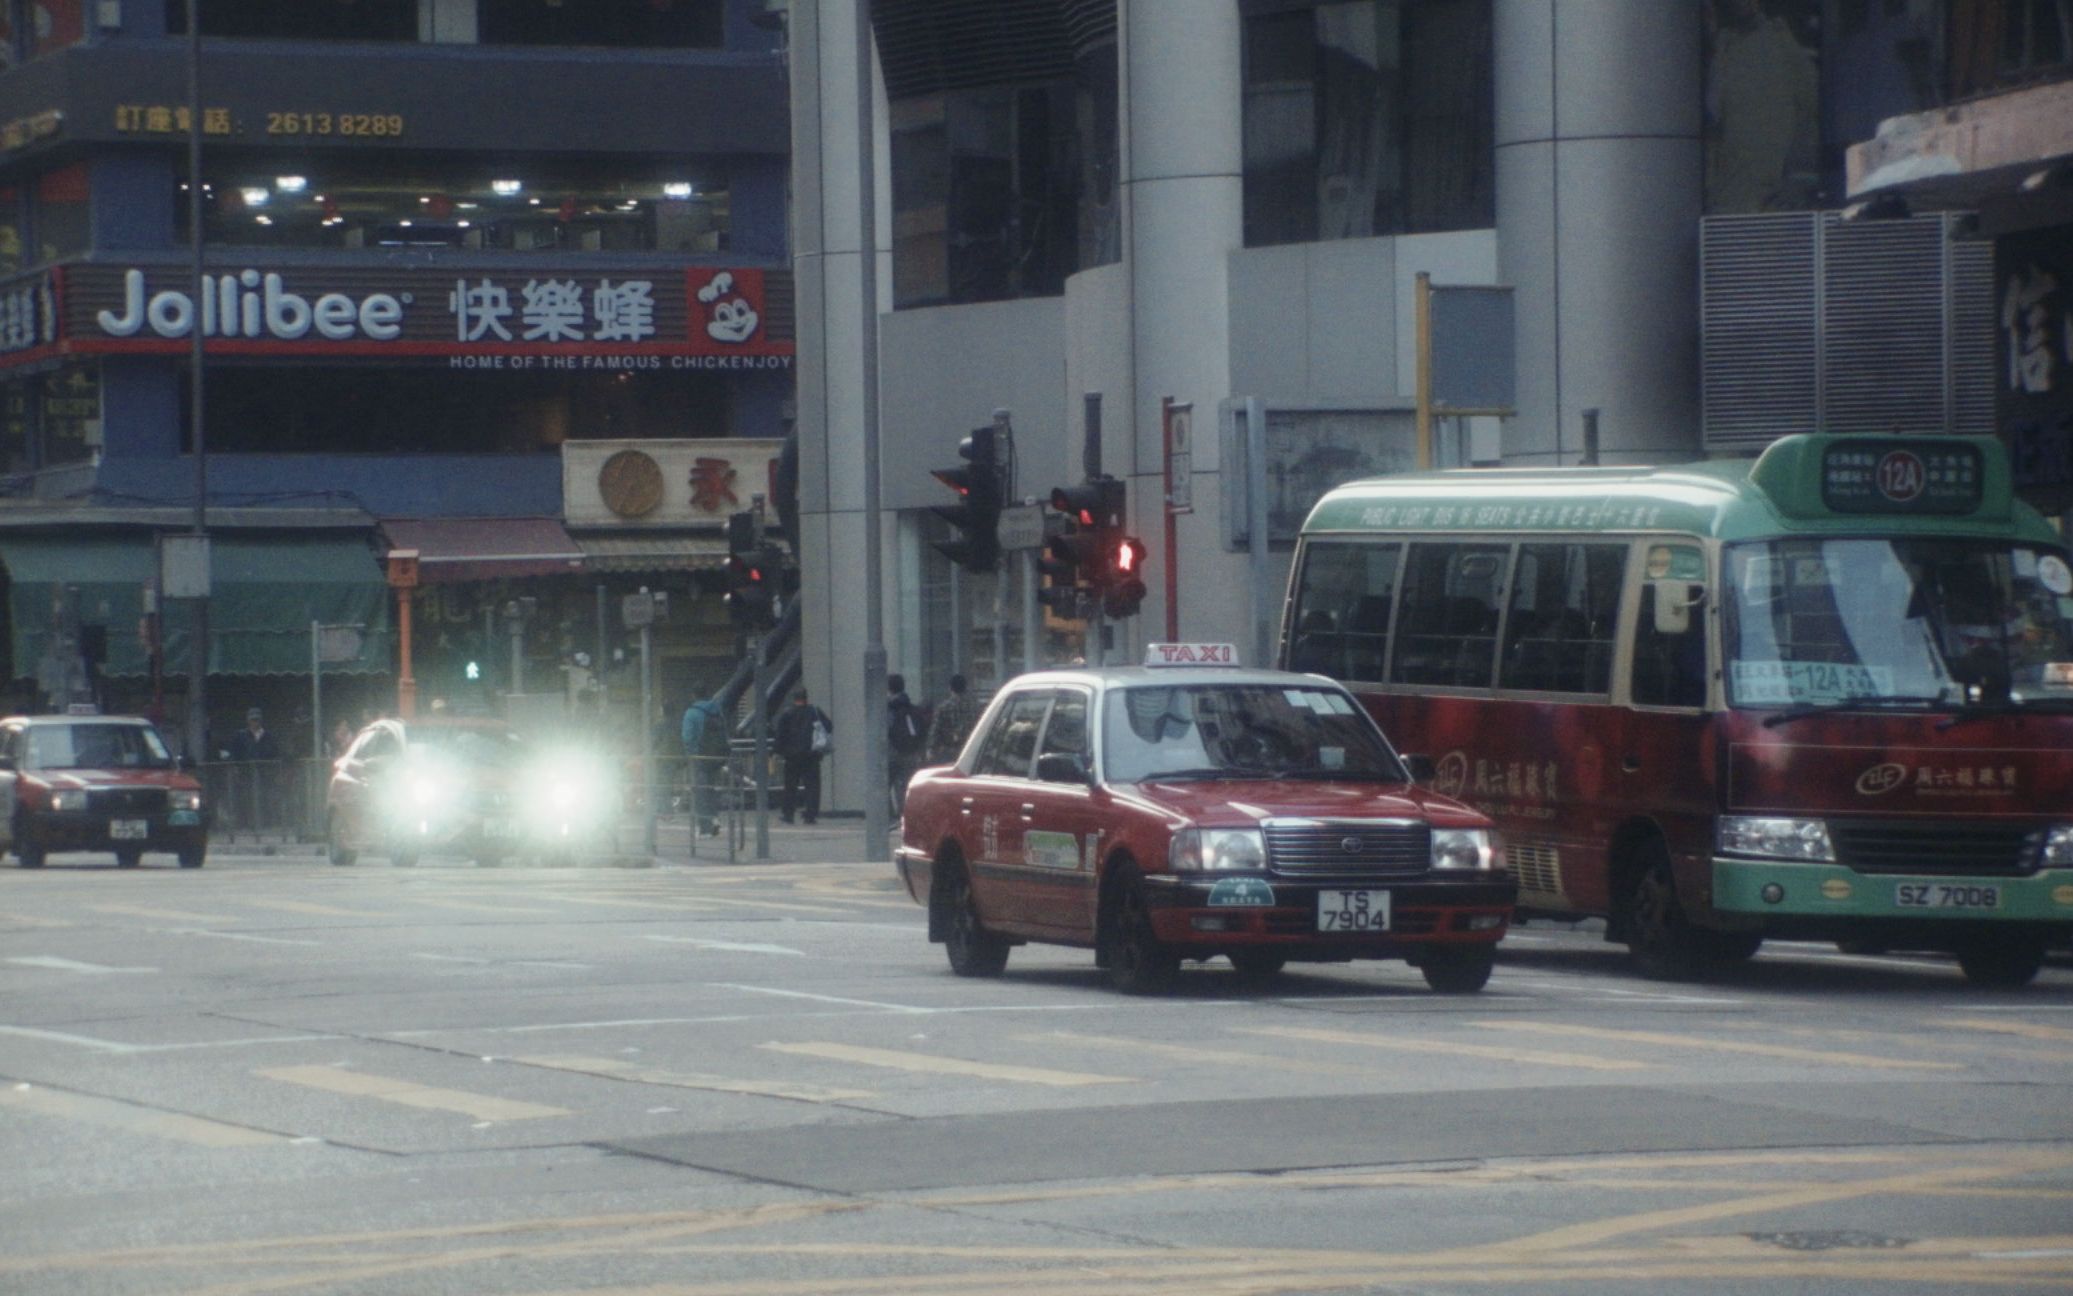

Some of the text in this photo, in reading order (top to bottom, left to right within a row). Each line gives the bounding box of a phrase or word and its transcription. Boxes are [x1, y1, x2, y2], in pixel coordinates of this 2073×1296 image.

[267, 111, 332, 134] 2613
[339, 114, 401, 136] 8289
[97, 268, 402, 340] Jollibee
[449, 278, 656, 343] 快樂蜂
[450, 356, 791, 369] HOME OF THE FAMOUS CHICKENJOY
[1884, 461, 1917, 491] 12A
[1158, 645, 1231, 662] TAXI
[1806, 664, 1842, 692] 12A
[1234, 883, 1248, 896] 4
[1900, 885, 1930, 905] SZ
[1338, 891, 1370, 910] TS
[1323, 910, 1385, 929] 7904
